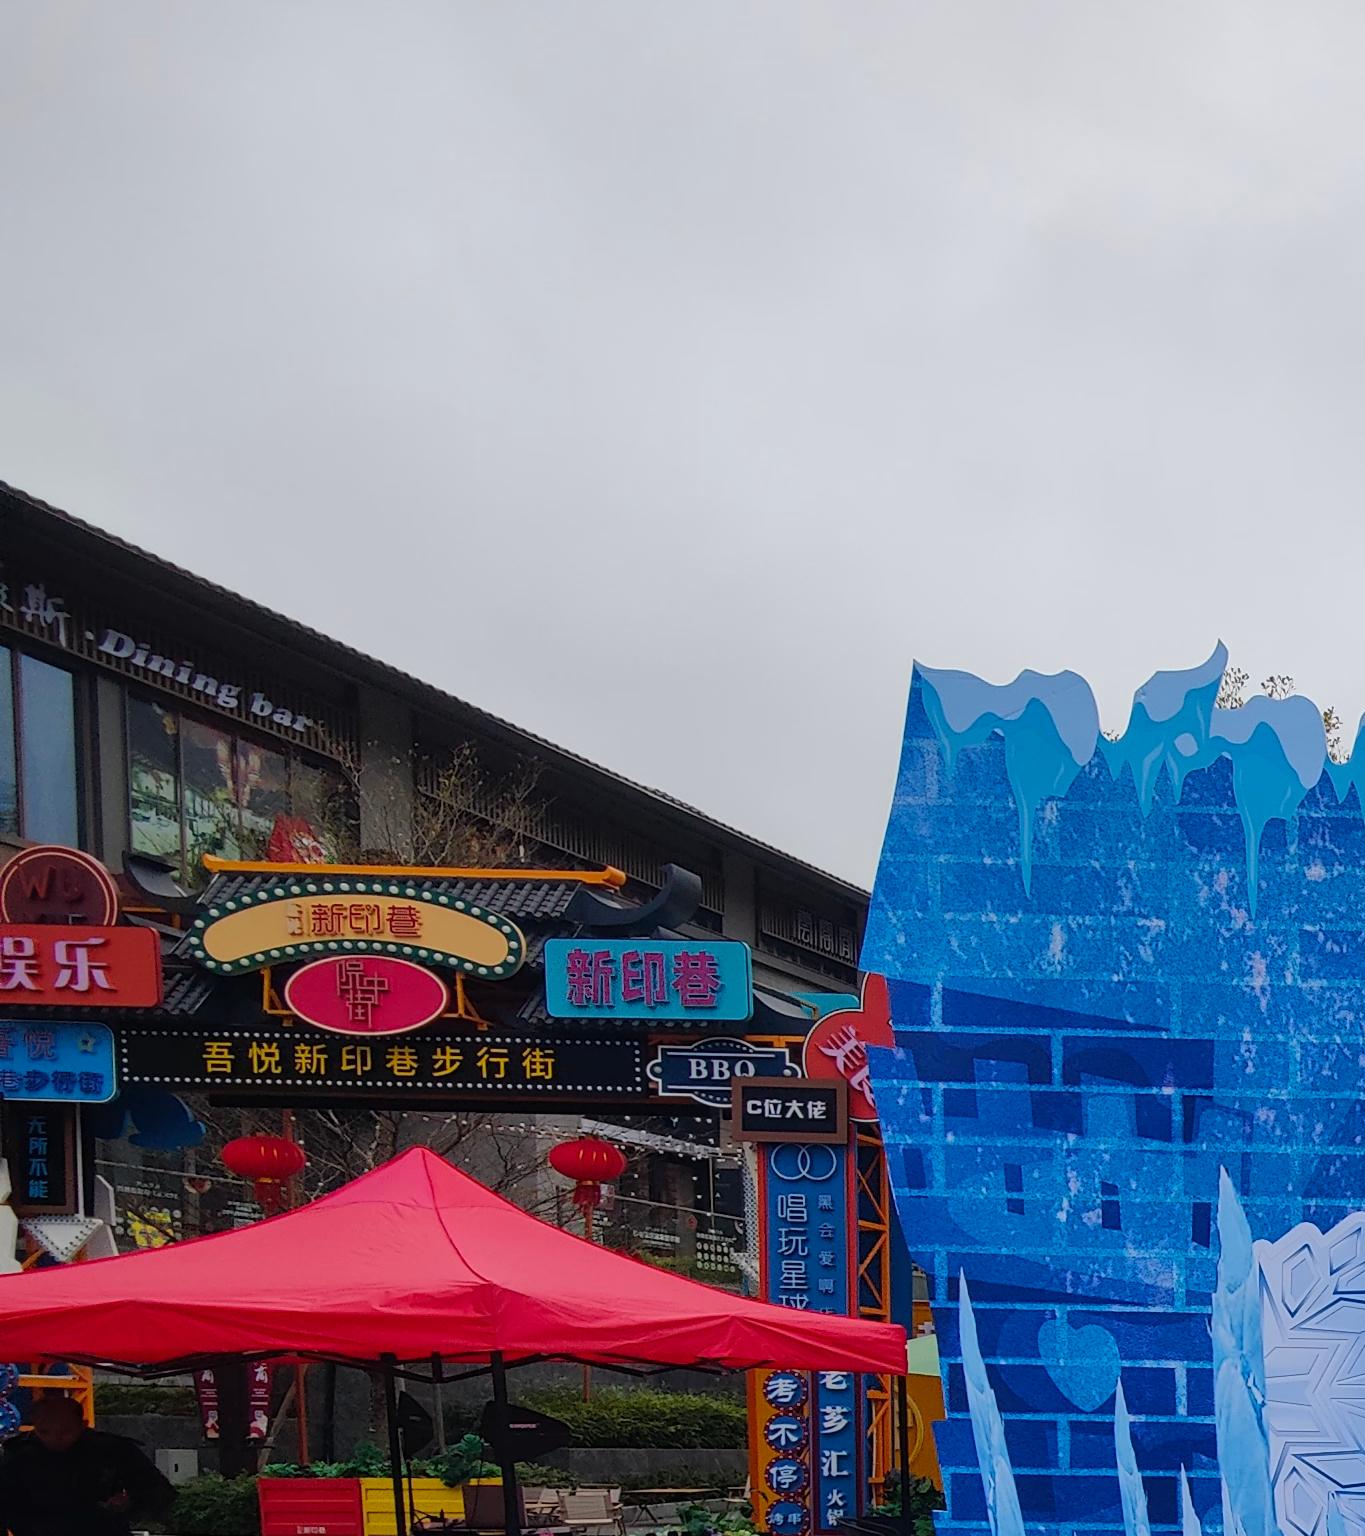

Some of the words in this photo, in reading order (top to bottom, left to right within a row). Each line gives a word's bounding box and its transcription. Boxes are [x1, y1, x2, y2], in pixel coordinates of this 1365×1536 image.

[98, 629, 242, 709] Dining
[250, 692, 314, 732] bar
[567, 949, 722, 1007] 新印巷
[202, 1041, 555, 1080] 吾悦新印巷步行街
[688, 1058, 756, 1080] BBQ
[746, 1099, 827, 1120] C位大佬
[27, 1115, 48, 1199] 无所不能
